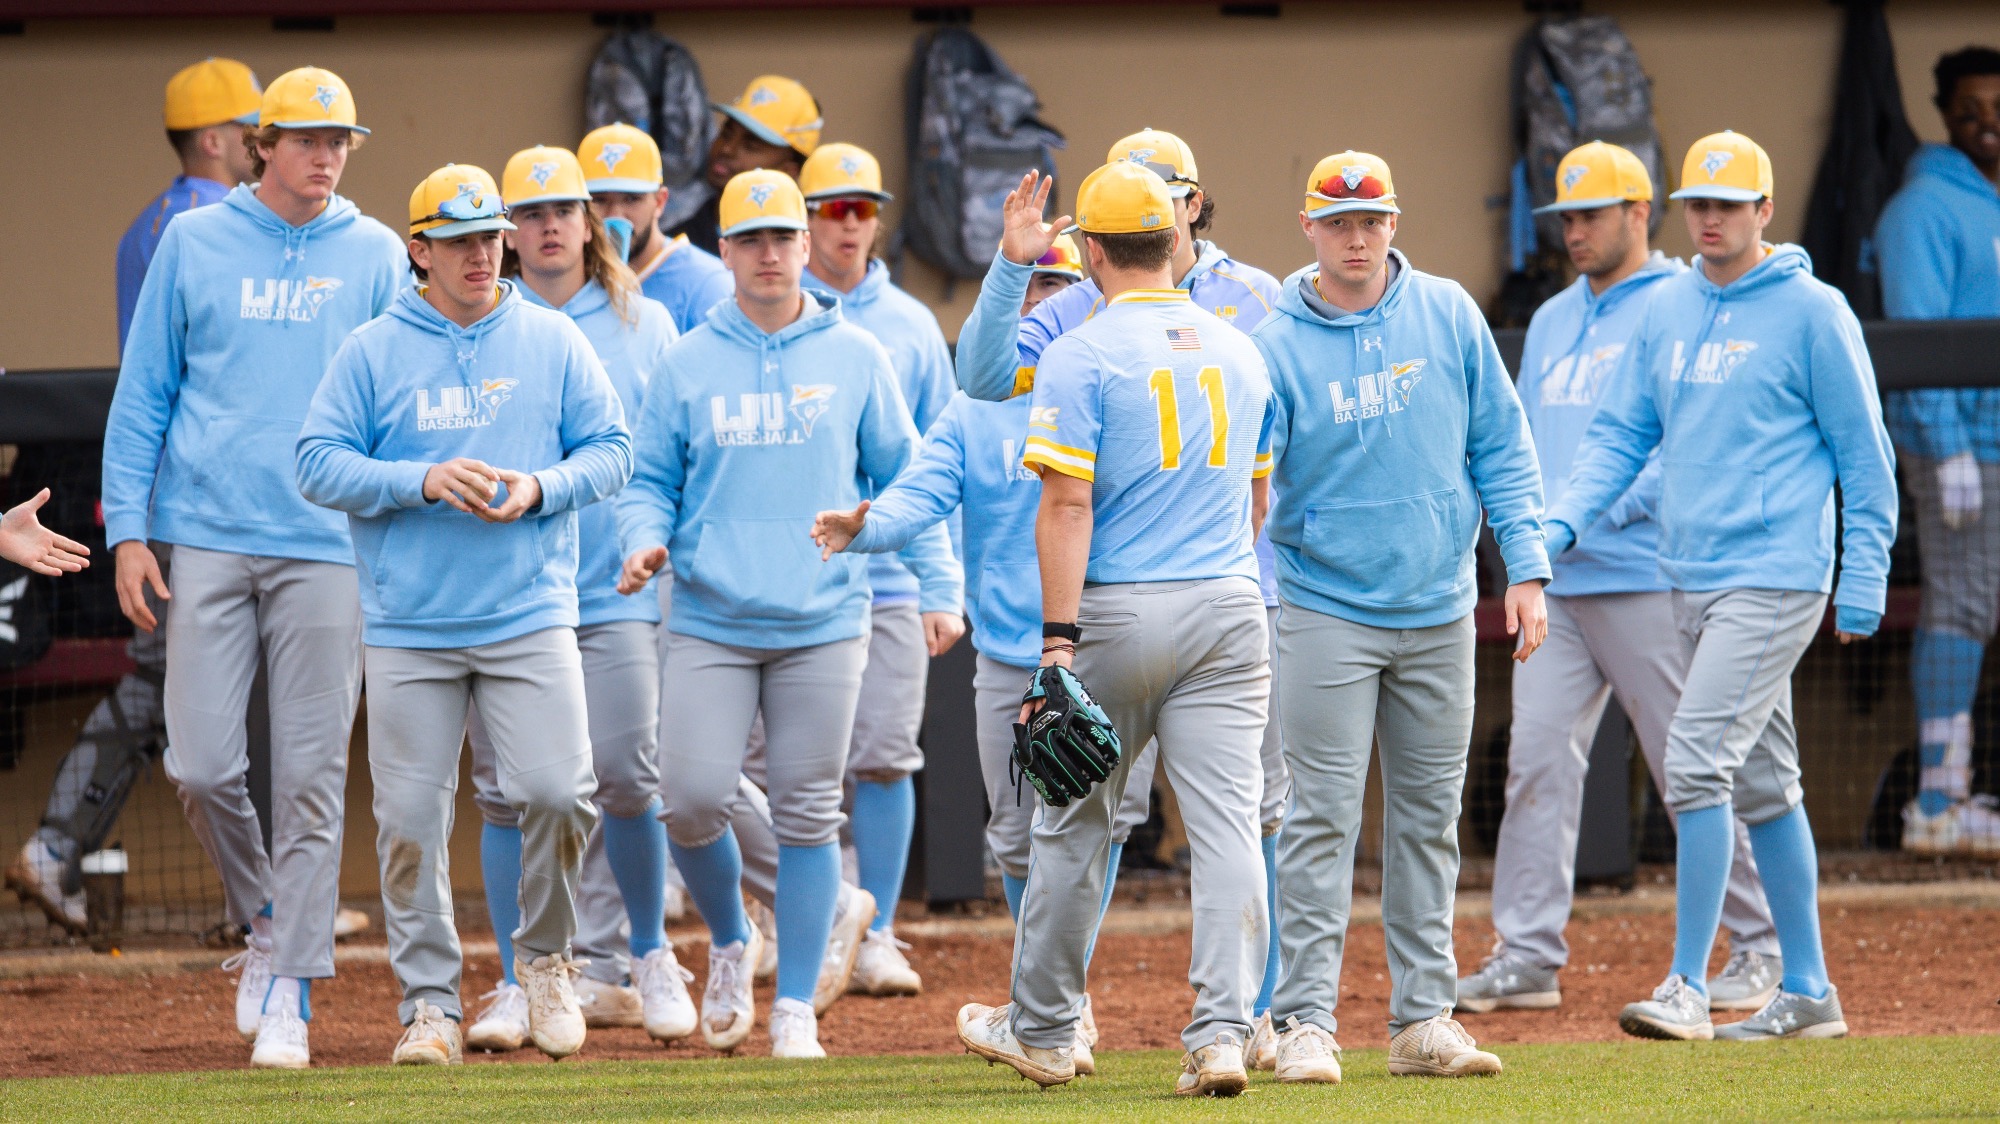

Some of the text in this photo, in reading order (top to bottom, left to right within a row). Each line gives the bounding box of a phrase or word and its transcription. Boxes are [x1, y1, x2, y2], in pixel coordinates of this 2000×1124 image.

[241, 278, 302, 308] LIU
[417, 386, 479, 419] LIU
[1328, 371, 1392, 412] LIU
[417, 415, 490, 431] BASEBALL
[711, 392, 785, 432] LIU
[1147, 365, 1231, 471] 11
[716, 429, 804, 446] BASEBALL
